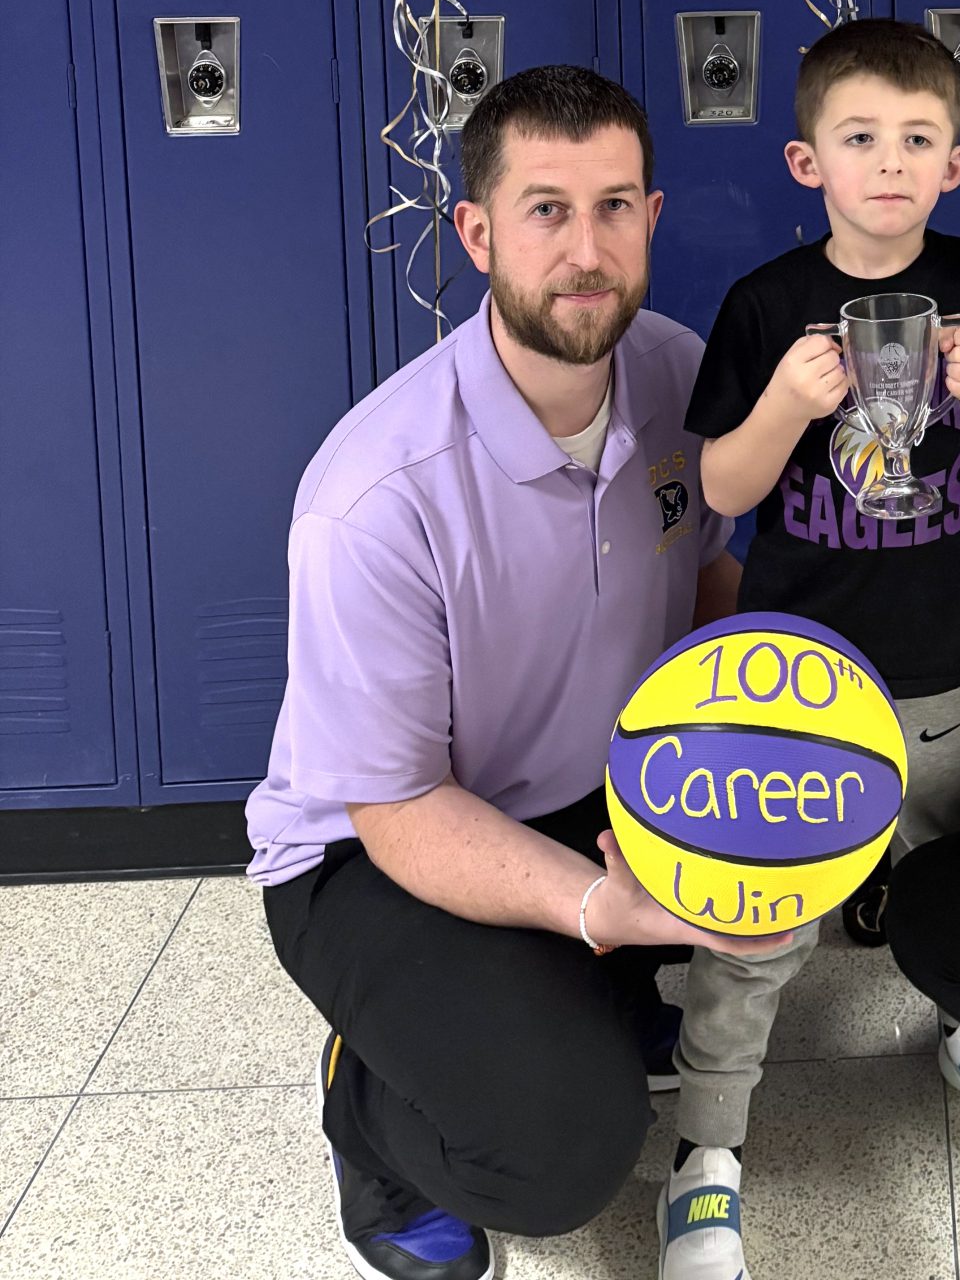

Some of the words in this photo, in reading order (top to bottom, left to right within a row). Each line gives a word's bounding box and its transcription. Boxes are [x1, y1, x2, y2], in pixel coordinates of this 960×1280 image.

[694, 641, 863, 709] 100th
[640, 735, 865, 824] Career
[673, 861, 804, 924] Win
[686, 1193, 731, 1224] NIKE
